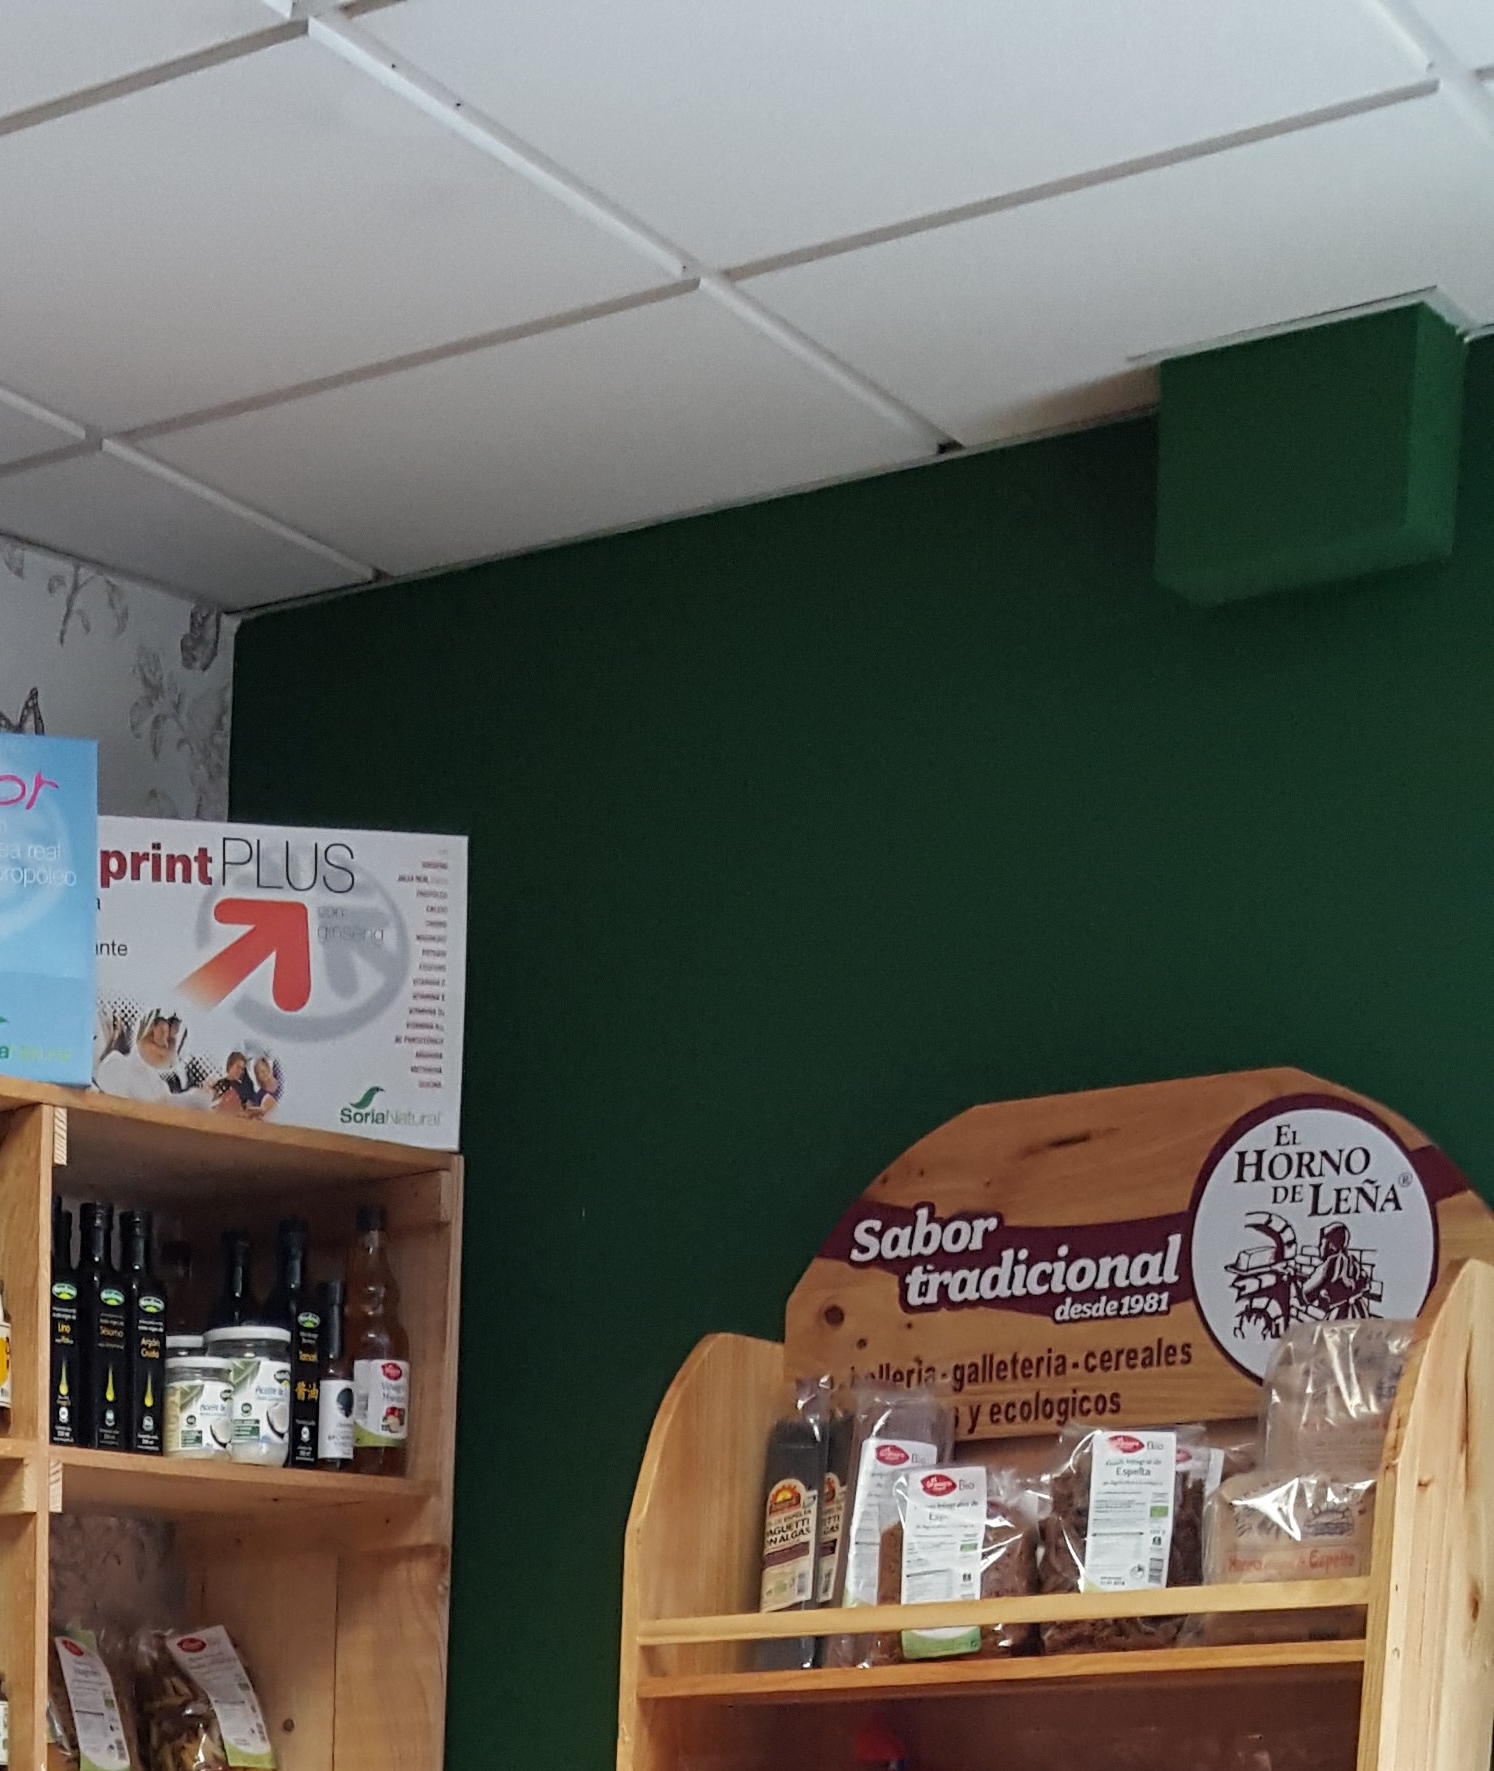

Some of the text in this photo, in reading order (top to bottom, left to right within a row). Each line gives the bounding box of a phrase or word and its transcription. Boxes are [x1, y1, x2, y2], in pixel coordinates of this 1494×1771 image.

[1233, 1147, 1371, 1185] HORNO
[1271, 1177, 1404, 1218] DE LEÑA
[850, 1206, 1000, 1263] Sabor
[905, 1232, 1183, 1308] tradicional
[1054, 1292, 1170, 1323] desde 1981
[968, 1388, 1122, 1434] y ecologicos
[1115, 1465, 1152, 1478] Espelta
